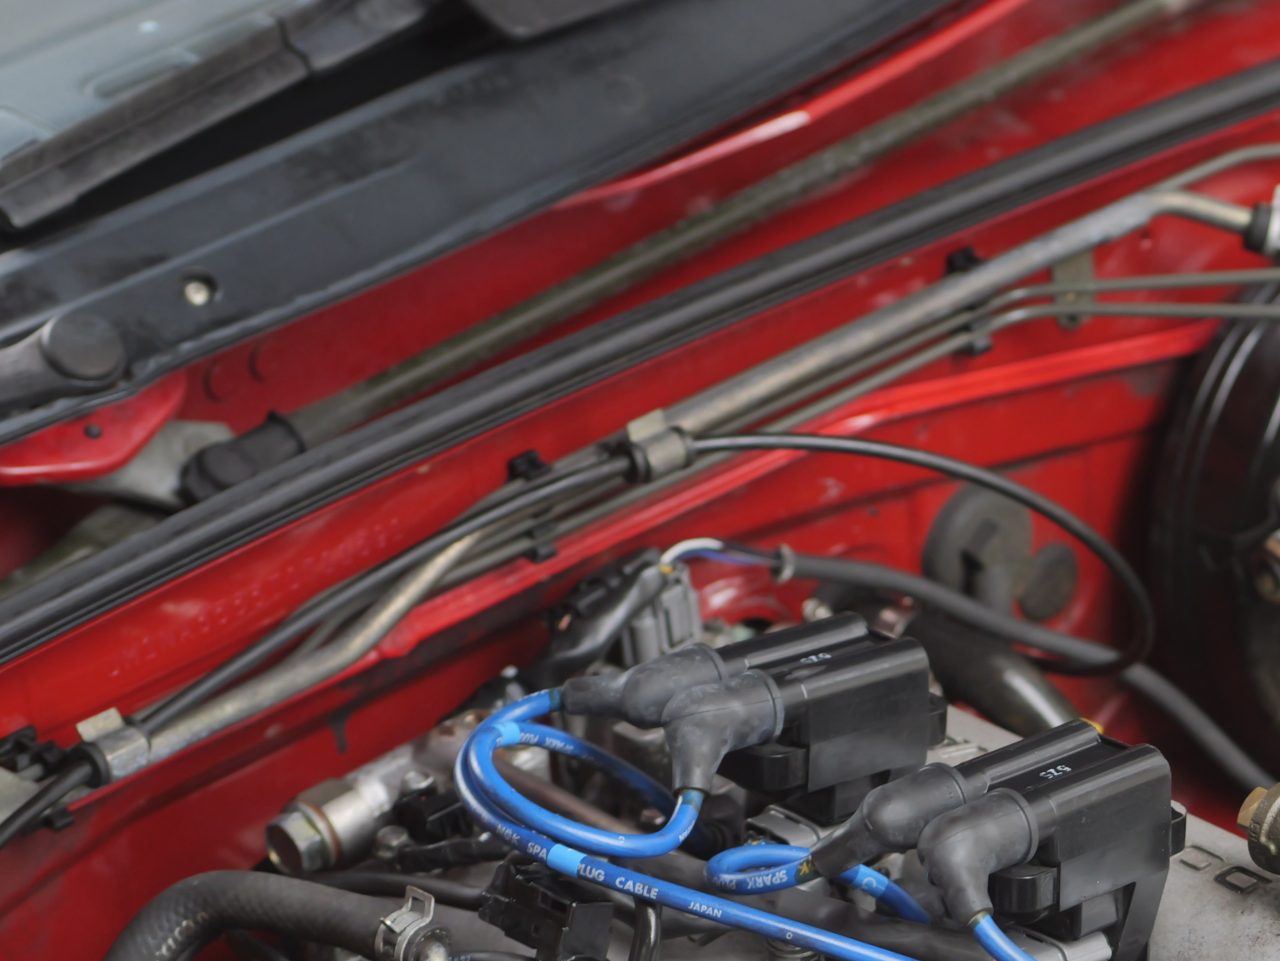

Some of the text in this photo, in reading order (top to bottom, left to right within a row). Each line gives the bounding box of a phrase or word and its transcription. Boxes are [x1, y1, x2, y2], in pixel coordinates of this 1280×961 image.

[747, 870, 788, 889] SPARK
[615, 876, 658, 900] CABLE
[687, 901, 722, 918] JAPAN
